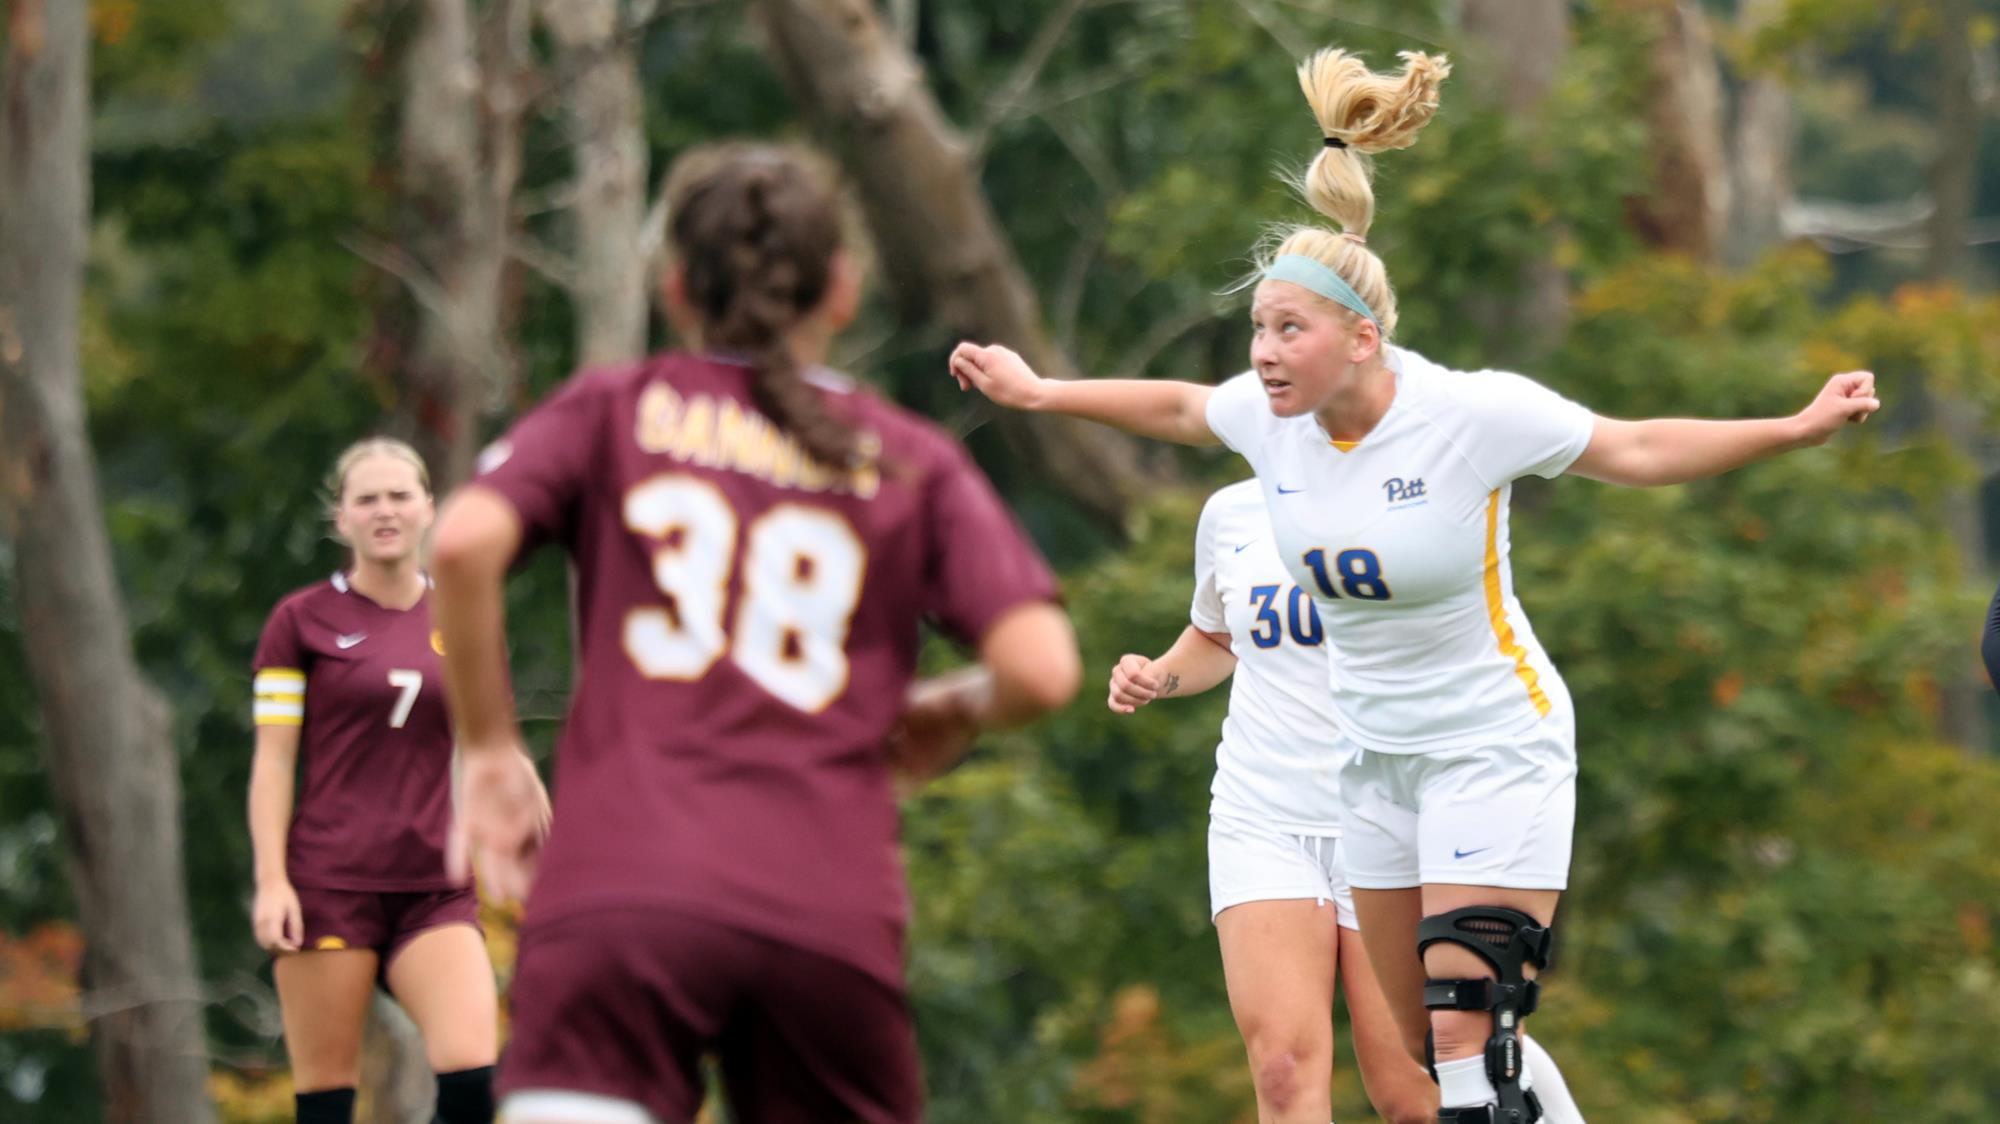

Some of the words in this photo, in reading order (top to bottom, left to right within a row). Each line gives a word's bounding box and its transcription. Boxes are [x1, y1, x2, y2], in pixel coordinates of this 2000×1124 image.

[1382, 477, 1427, 502] Pitt
[623, 473, 868, 715] 38
[1303, 547, 1393, 601] 18
[1249, 583, 1325, 650] 30
[387, 668, 423, 729] 7
